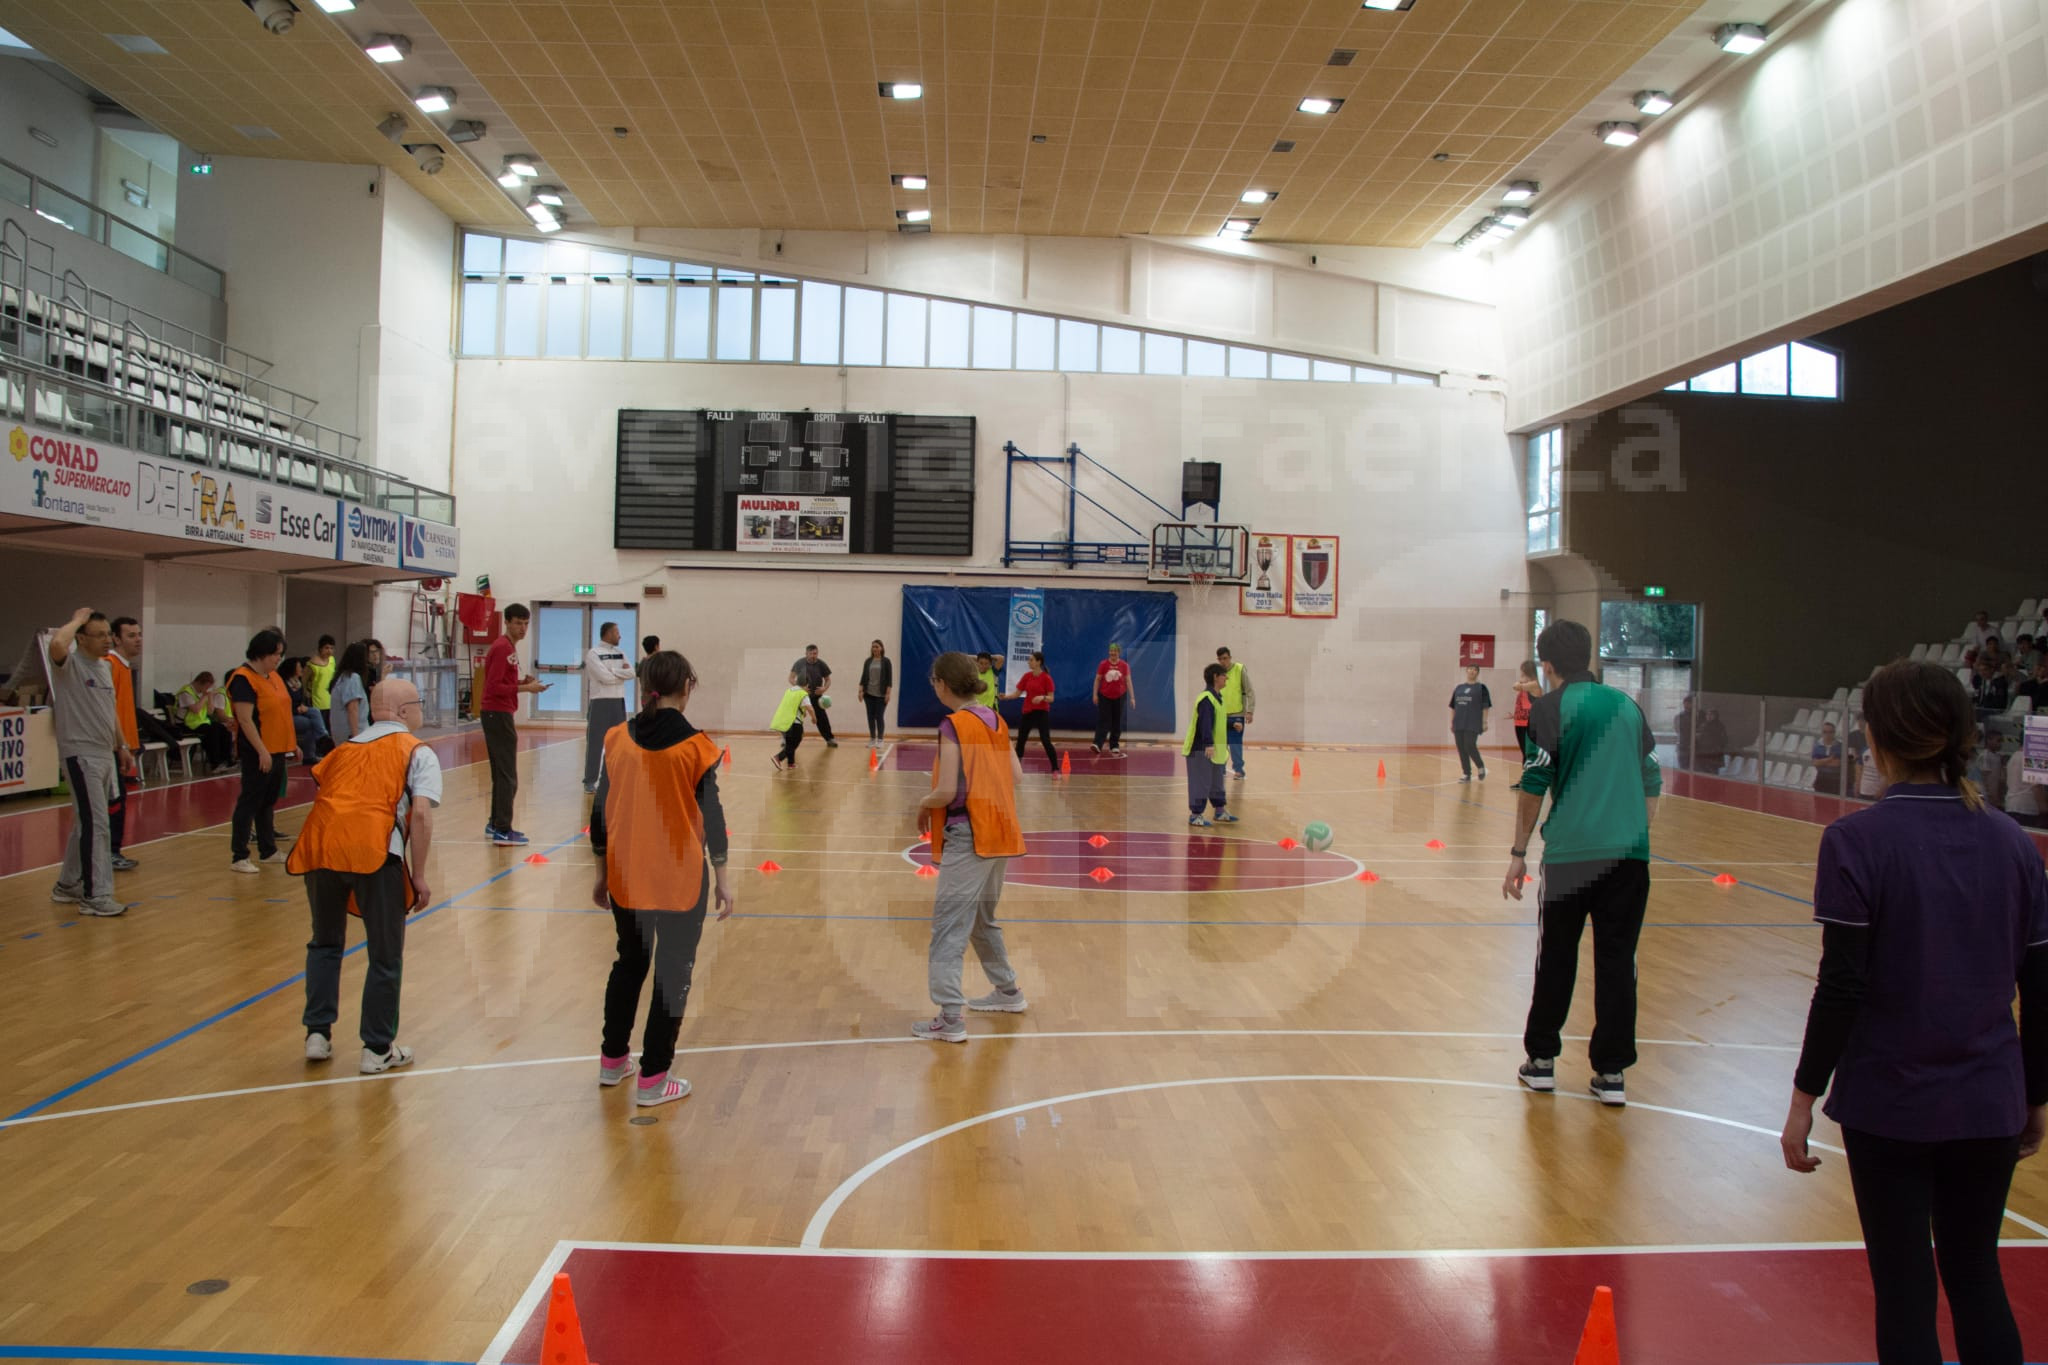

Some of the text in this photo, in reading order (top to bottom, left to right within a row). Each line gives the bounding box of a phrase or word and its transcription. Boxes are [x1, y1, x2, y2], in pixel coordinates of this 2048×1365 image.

[707, 412, 734, 421] FALLI
[757, 412, 781, 421] LOCALI
[814, 413, 836, 422] OSPITI
[858, 414, 886, 424] FALLI
[30, 435, 99, 473] CONAD
[53, 468, 131, 498] SUPERMERCATO
[740, 499, 800, 511] MULINARI
[280, 505, 336, 544] Esse Car
[350, 506, 396, 545] OLYMPIA
[185, 524, 245, 543] BIRRA ARTIGIANALE
[249, 528, 277, 542] SEAT
[363, 554, 385, 565] RAVENNA
[1245, 591, 1265, 599] Coppa
[0, 717, 24, 738] RO
